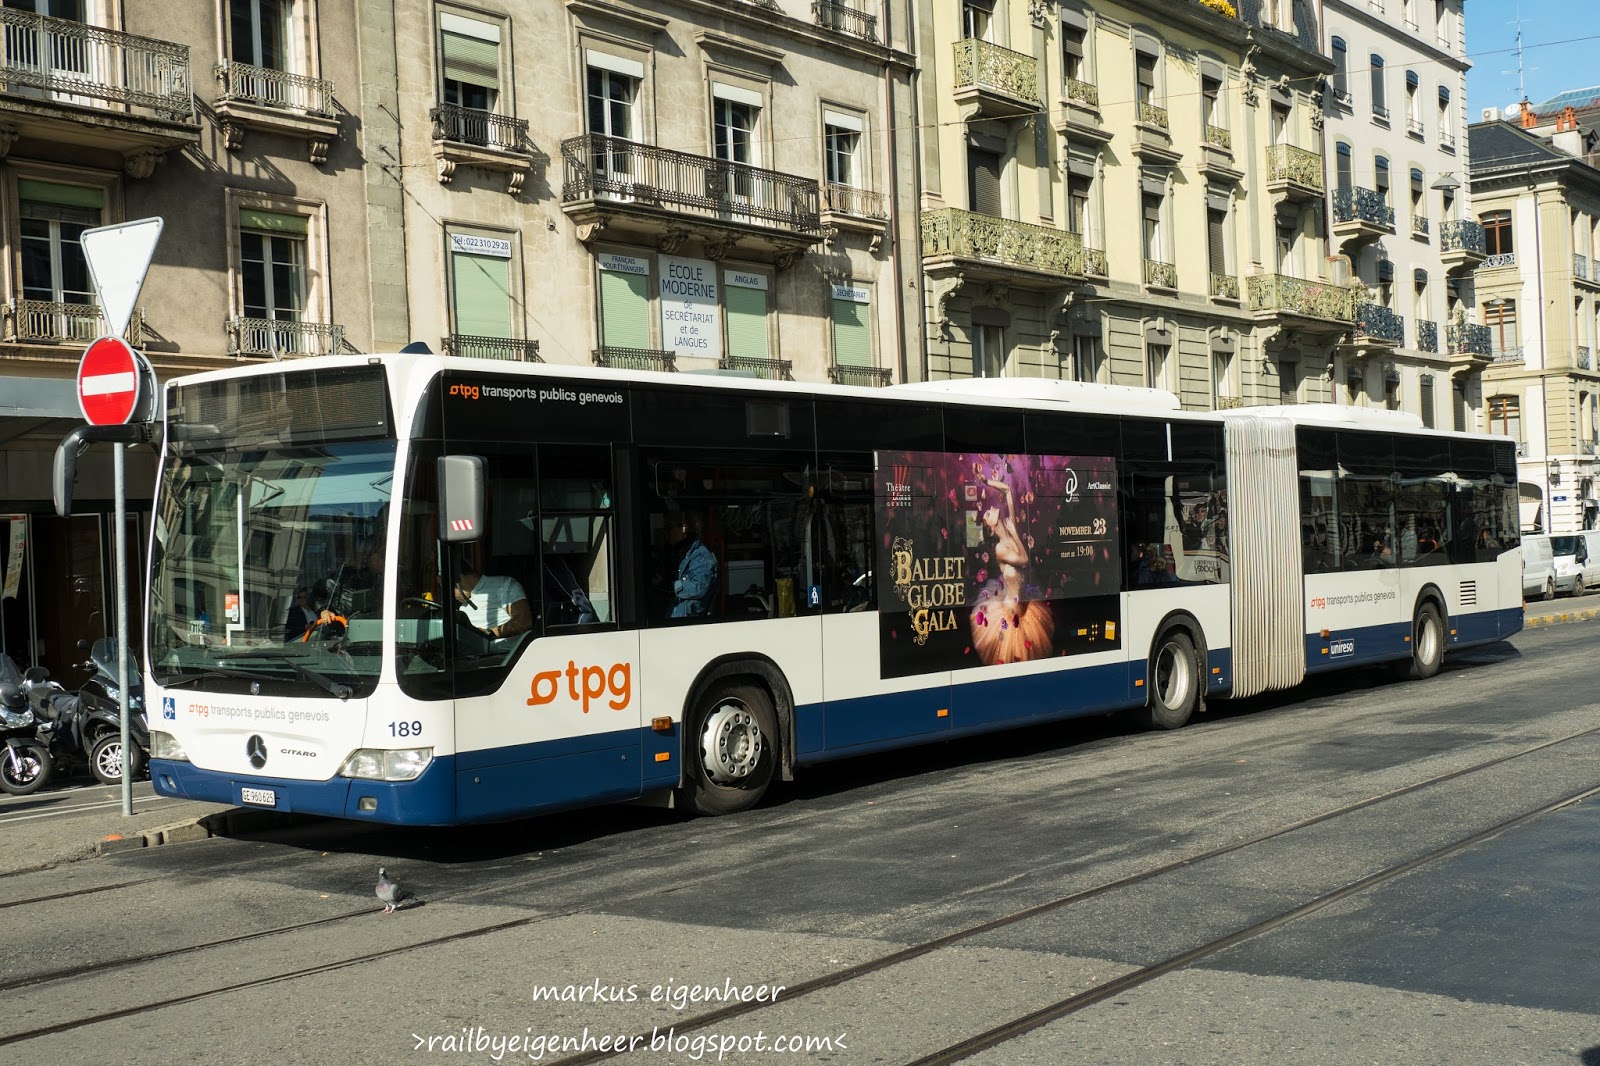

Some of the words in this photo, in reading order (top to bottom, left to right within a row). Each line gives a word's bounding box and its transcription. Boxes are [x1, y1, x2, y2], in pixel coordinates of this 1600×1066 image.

[466, 238, 478, 246] 022
[480, 240, 491, 248] 310
[501, 242, 508, 250] 28
[612, 256, 636, 265] FRANÇAIS
[618, 263, 645, 274] ÉTRANGERS
[669, 262, 703, 282] ÉCOLE
[734, 275, 758, 286] ANGLAIS
[662, 280, 714, 298] MODERNE
[684, 300, 692, 310] de
[665, 310, 714, 324] SECRÉTARIAT
[680, 326, 688, 334] et
[690, 326, 698, 335] de
[674, 336, 708, 348] LANGUES
[482, 385, 536, 401] transports
[539, 388, 576, 402] publics
[578, 392, 623, 405] genevois
[886, 482, 910, 492] Théâtre
[1060, 526, 1092, 536] NOVEMBER
[1092, 518, 1106, 534] 23
[1077, 546, 1094, 556] 19:00
[895, 550, 965, 584] BALLET
[908, 582, 966, 608] GLOBE
[1326, 596, 1353, 606] transports
[1354, 592, 1372, 605] publics
[1374, 590, 1396, 604] genevois
[914, 608, 958, 634] GALA
[1330, 642, 1353, 654] unireso
[211, 704, 252, 719] transports
[254, 707, 286, 720] publics
[288, 710, 330, 723] genevois
[388, 720, 422, 737] 189
[280, 748, 316, 758] CITARO
